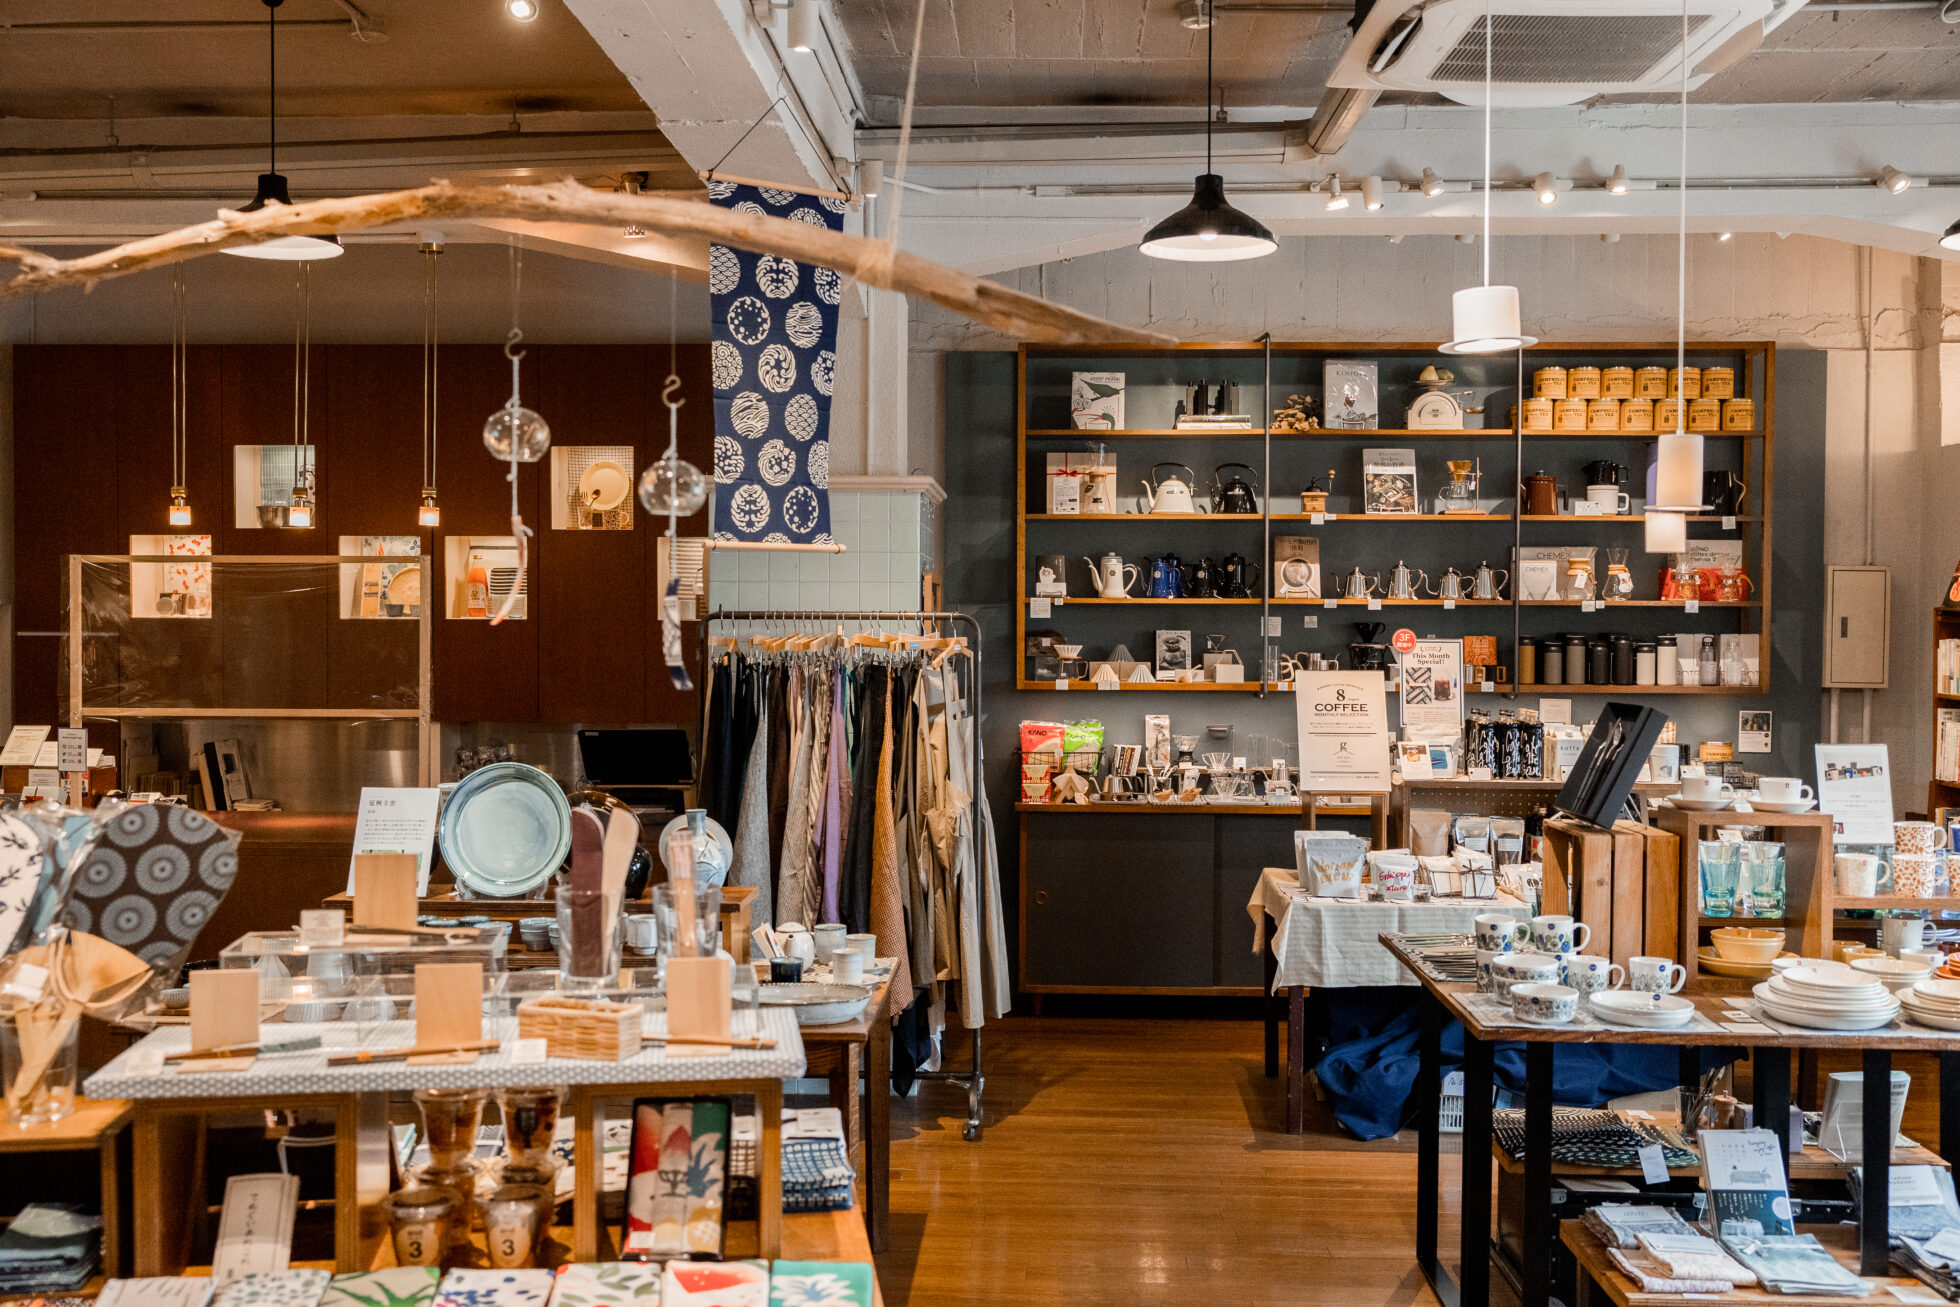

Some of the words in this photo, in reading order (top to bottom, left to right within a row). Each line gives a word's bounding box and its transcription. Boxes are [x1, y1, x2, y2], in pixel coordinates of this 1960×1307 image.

[1399, 633, 1411, 642] 3F
[1336, 688, 1346, 702] 8
[1314, 703, 1369, 712] COFFEE
[409, 1241, 422, 1258] 3
[502, 1240, 514, 1256] 3
